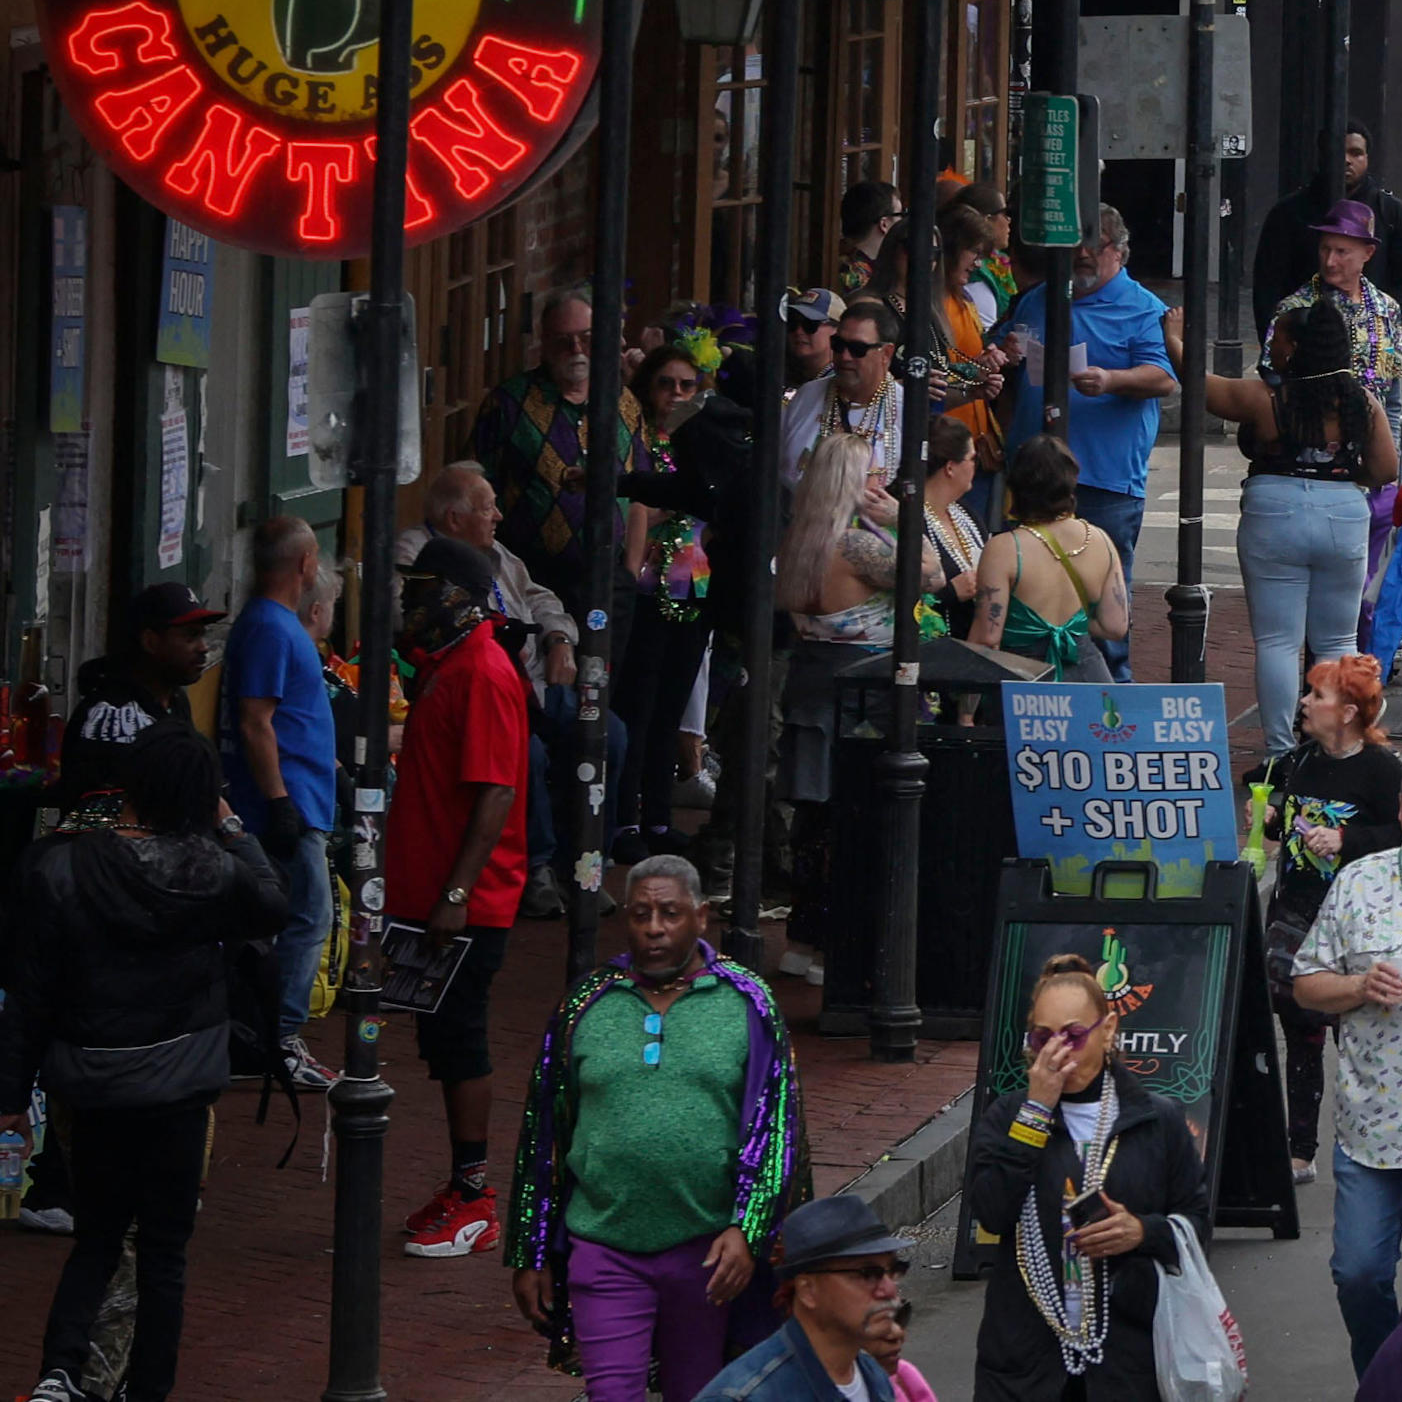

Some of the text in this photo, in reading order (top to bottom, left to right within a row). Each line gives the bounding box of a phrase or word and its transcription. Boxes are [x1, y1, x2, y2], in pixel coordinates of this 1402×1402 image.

[194, 14, 447, 114] HUGE AS
[168, 270, 205, 318] HOUR
[1012, 694, 1203, 719] DRINK BIG
[1019, 719, 1215, 744] EASY EASY
[1015, 745, 1222, 793] $10 BEER
[1040, 799, 1205, 840] + SHOT
